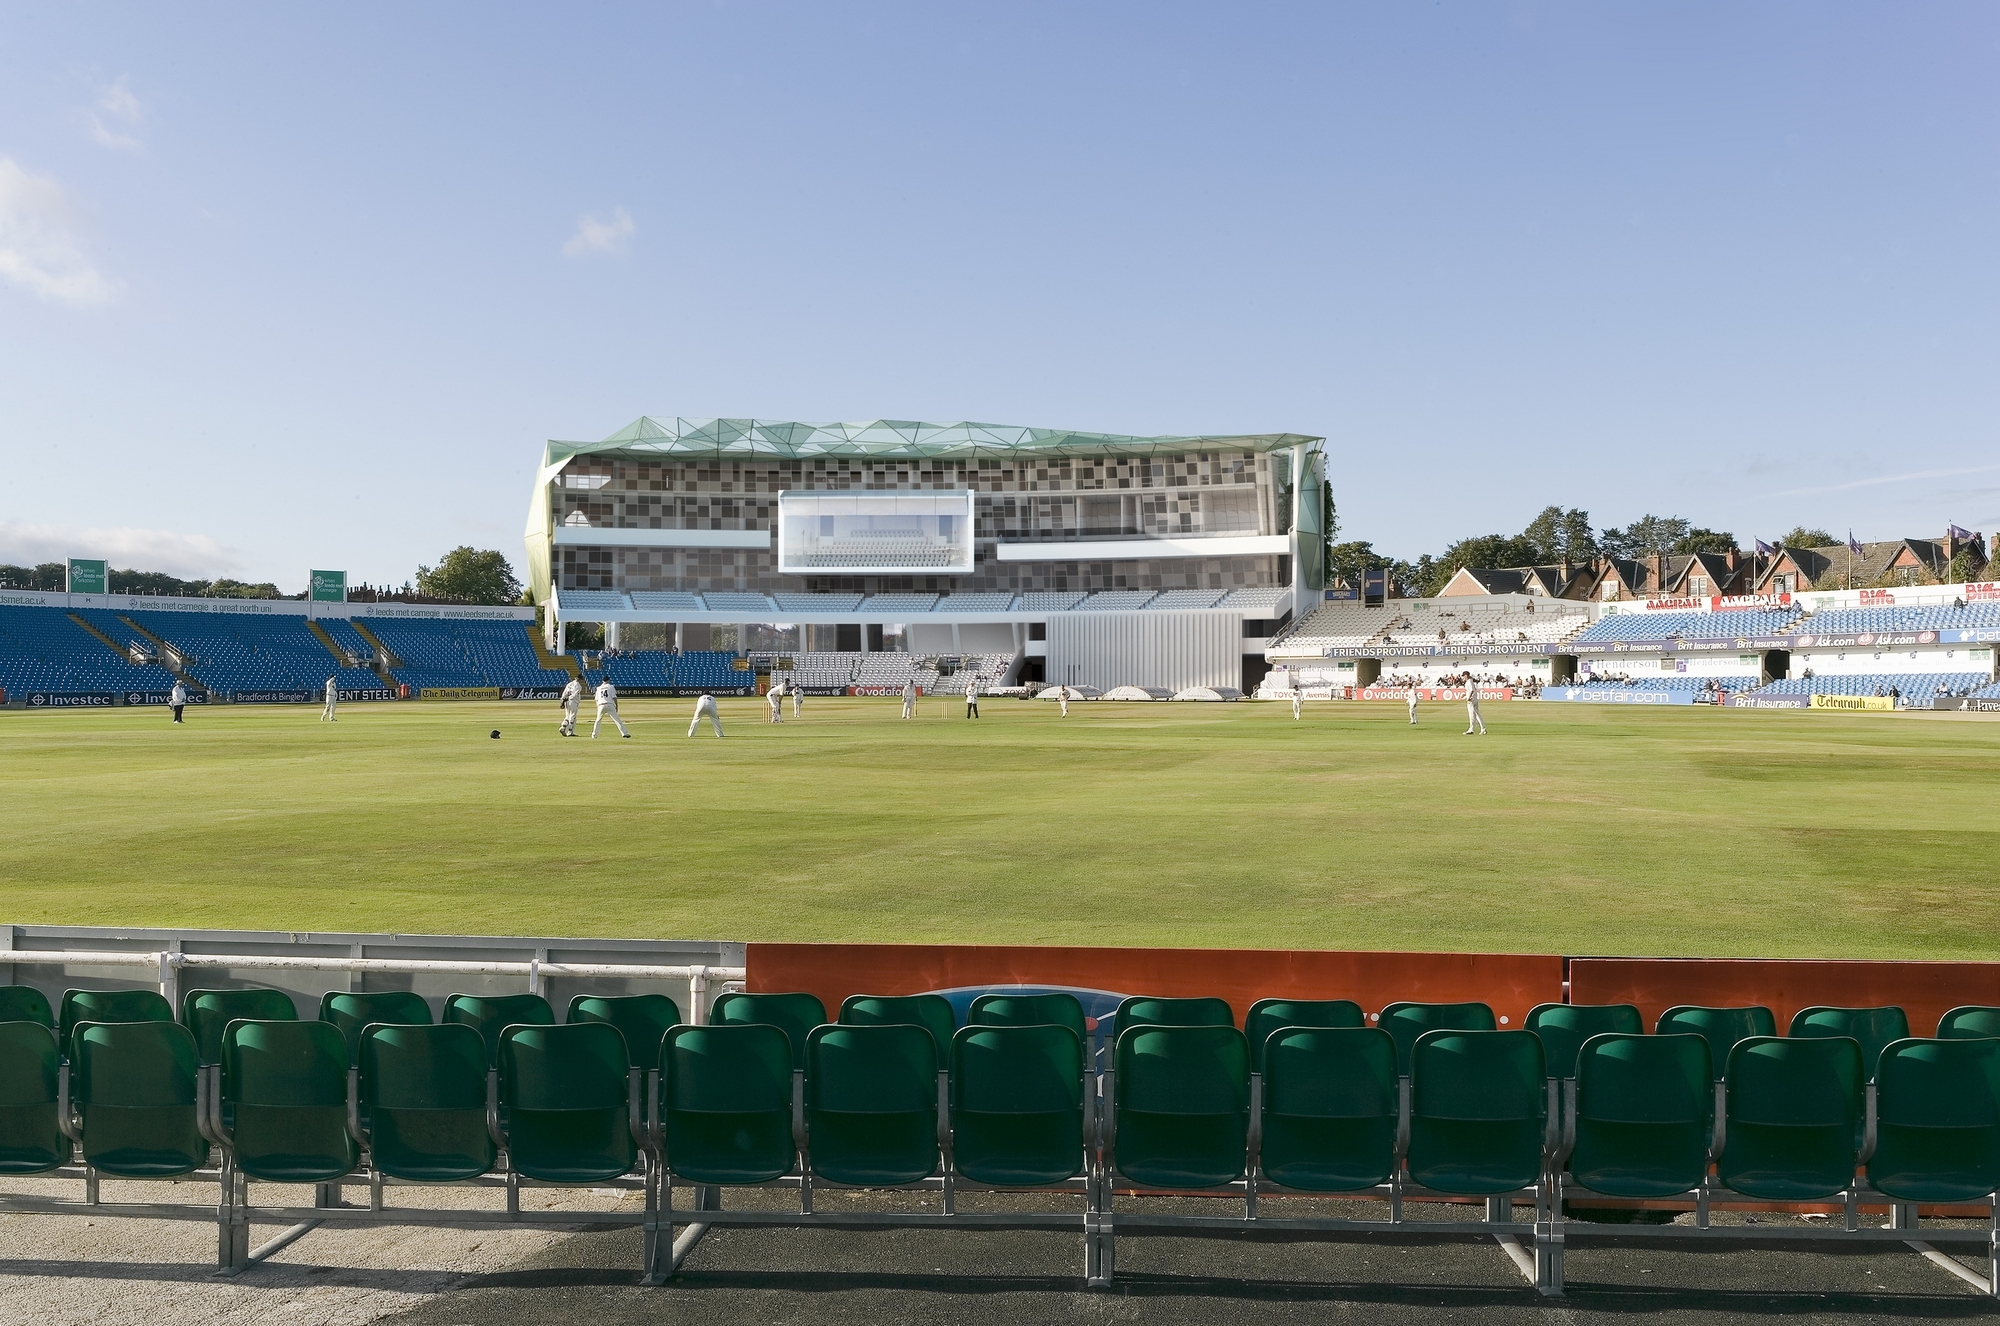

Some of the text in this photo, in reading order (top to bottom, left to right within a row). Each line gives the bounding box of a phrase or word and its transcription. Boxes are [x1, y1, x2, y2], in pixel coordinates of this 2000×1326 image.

[1859, 589, 1895, 606] Biffa
[139, 601, 160, 610] leeds
[161, 602, 177, 610] met
[178, 603, 209, 613] carnegie
[219, 605, 238, 614] great
[239, 605, 259, 613] north
[260, 605, 272, 613] uni
[375, 607, 515, 619] leeds met carnegie www.leedsmet.ac.uk
[1558, 639, 1788, 653] Brit Insurance Brit Insurance Brit Insurance Brit Insurance
[1815, 634, 1855, 647] Ask.com
[1875, 633, 1916, 645] Ask.com
[1333, 644, 1547, 657] FRIENDS PROVIDENT FRIENDS PROVIDENT
[1596, 659, 1659, 669] Henderson
[1689, 658, 1739, 667] Henderson
[49, 693, 110, 706] Investec
[237, 691, 305, 703] Bradford & Bingley
[362, 690, 396, 700] STEEL
[422, 688, 499, 700] The Daily Telegraph
[517, 688, 559, 700] Ask.com
[1305, 691, 1330, 699] Avensis
[1374, 689, 1424, 700] vodafoe
[1582, 689, 1669, 703] betfair.com
[1735, 697, 1800, 709] Brit Insurance
[1817, 694, 1888, 710] Telegraph.co.uk
